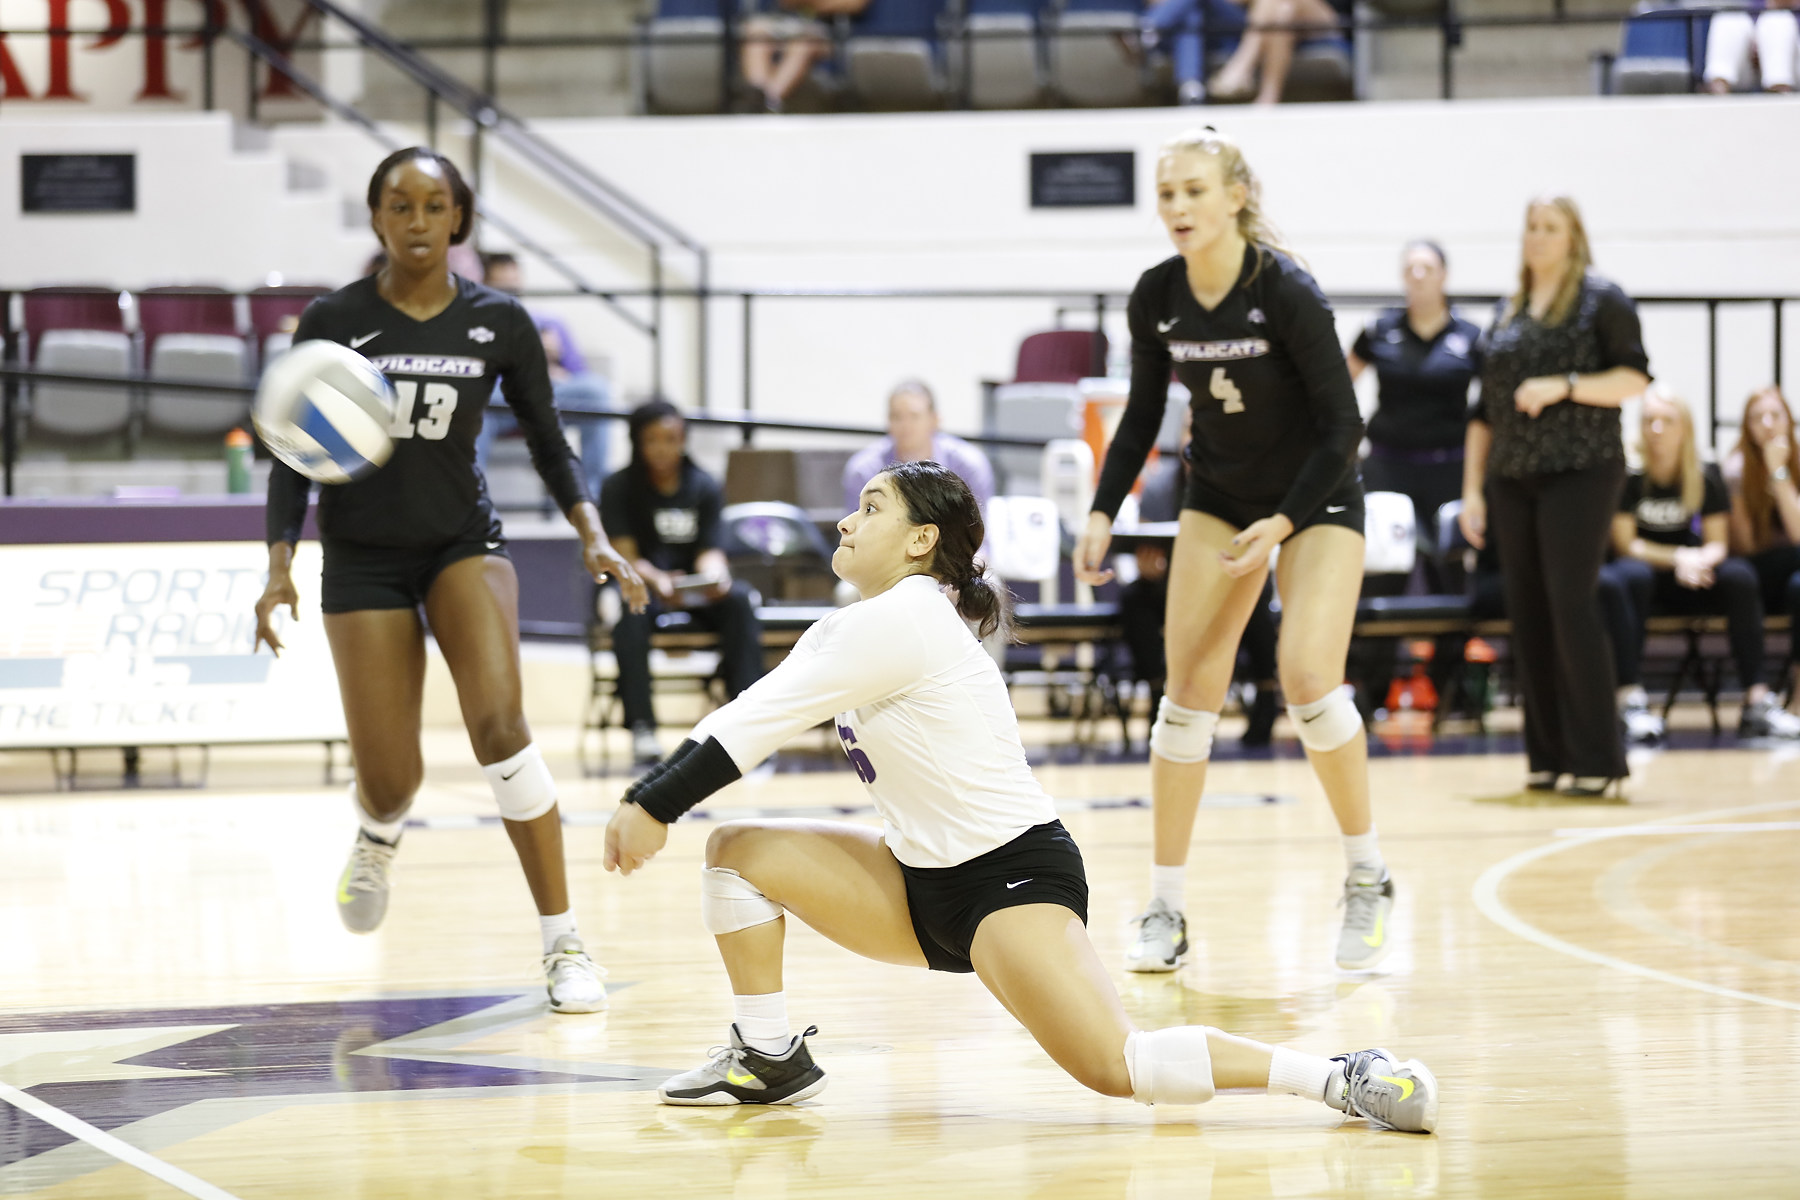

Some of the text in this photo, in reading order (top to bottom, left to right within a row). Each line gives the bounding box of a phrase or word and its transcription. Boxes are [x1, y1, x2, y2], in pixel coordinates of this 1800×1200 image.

[388, 380, 459, 440] 13
[1209, 367, 1245, 414] 4
[34, 568, 268, 607] SPORT
